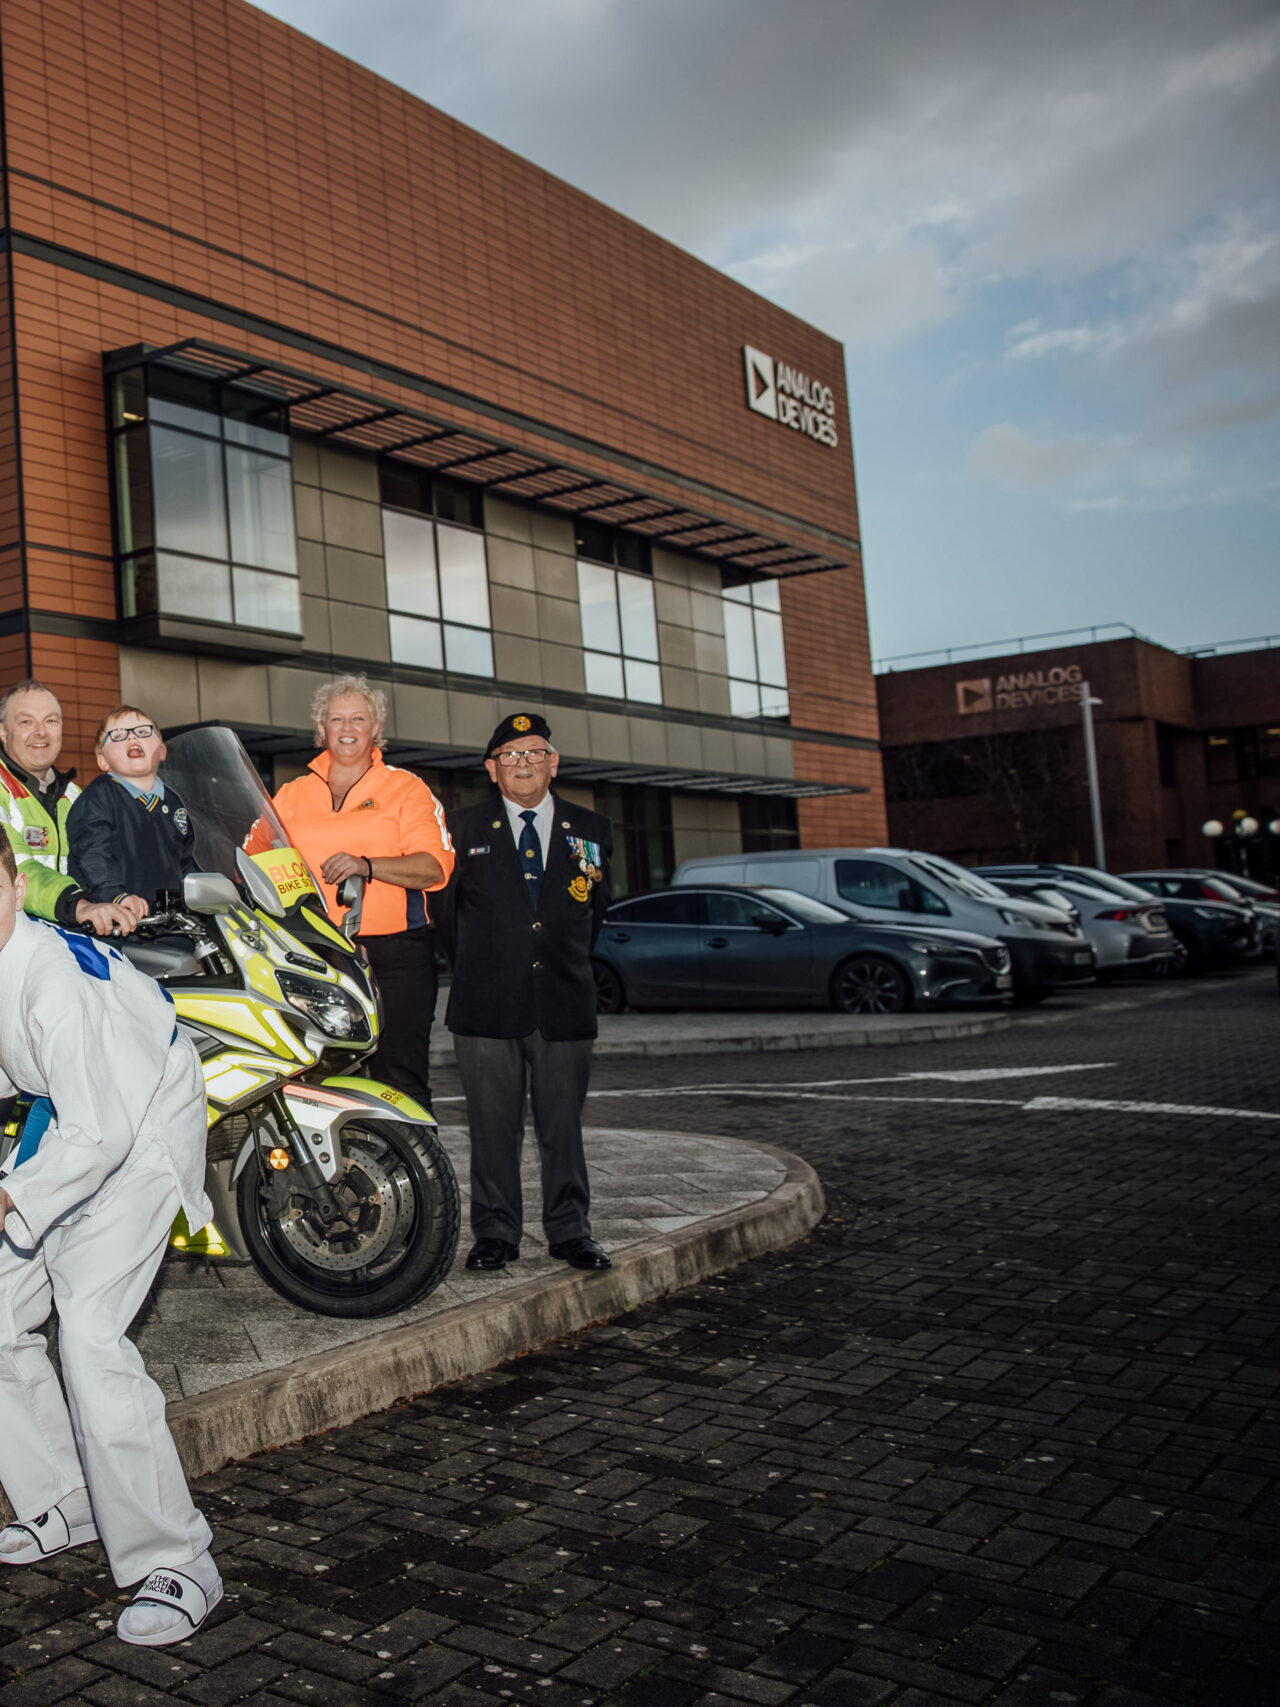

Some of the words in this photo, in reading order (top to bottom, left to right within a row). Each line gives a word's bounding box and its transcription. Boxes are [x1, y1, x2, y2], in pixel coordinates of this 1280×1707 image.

[777, 361, 835, 416] ANALOG
[777, 392, 838, 448] DEVICES
[995, 664, 1083, 692] ANALOG
[995, 685, 1082, 710] DEVICES
[278, 879, 302, 894] BIKE
[144, 1585, 166, 1594] FACE
[155, 1575, 172, 1583] THE
